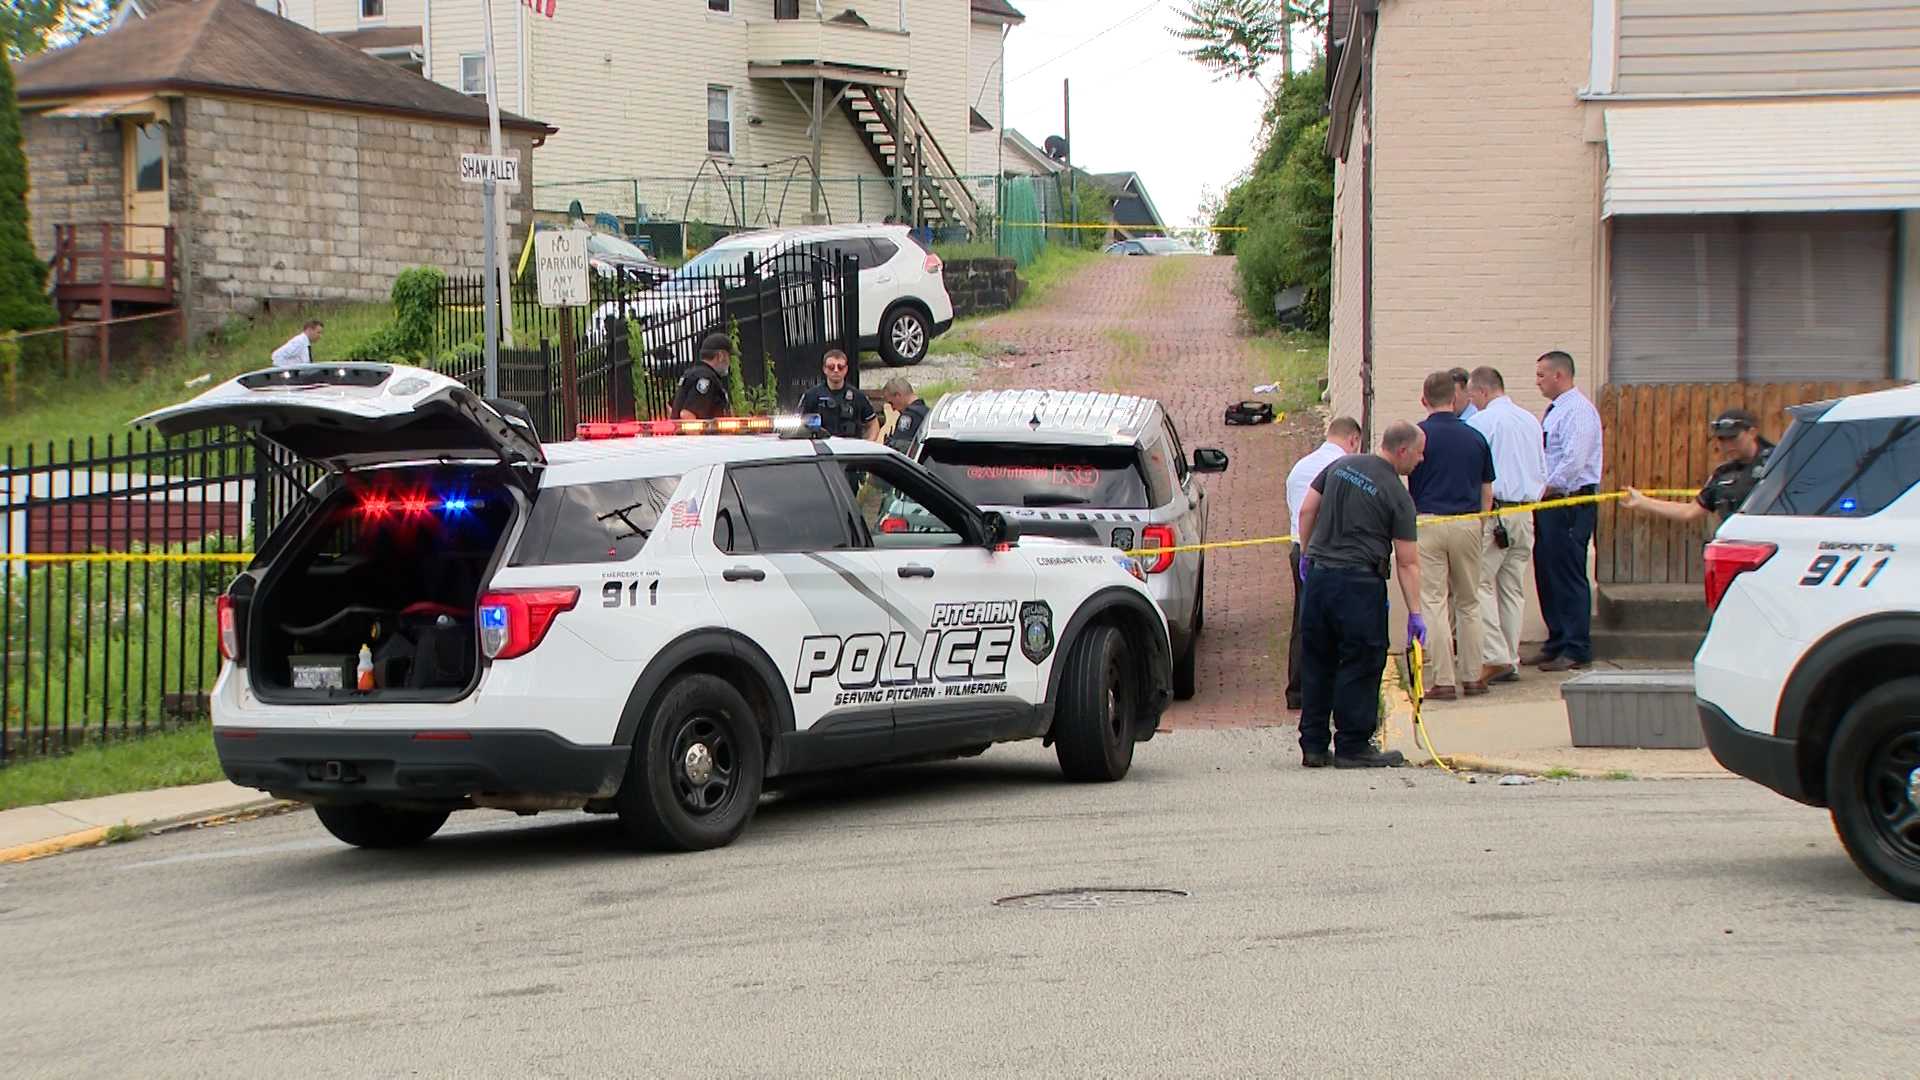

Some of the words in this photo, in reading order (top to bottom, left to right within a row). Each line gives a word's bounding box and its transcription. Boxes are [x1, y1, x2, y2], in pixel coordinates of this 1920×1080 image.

[462, 157, 488, 179] SHAW
[491, 159, 517, 181] ALLEY
[551, 239, 570, 252] NO
[540, 255, 584, 271] PARKING
[551, 288, 576, 299] TIME
[552, 274, 573, 289] ANY
[1798, 555, 1890, 588] 911
[602, 579, 659, 608] 911
[931, 600, 1017, 627] PITCAIRN
[794, 626, 1015, 694] POLICE
[834, 690, 883, 706] SERVING
[885, 687, 936, 702] PITCAIRN
[944, 681, 1008, 696] WILMERDING
